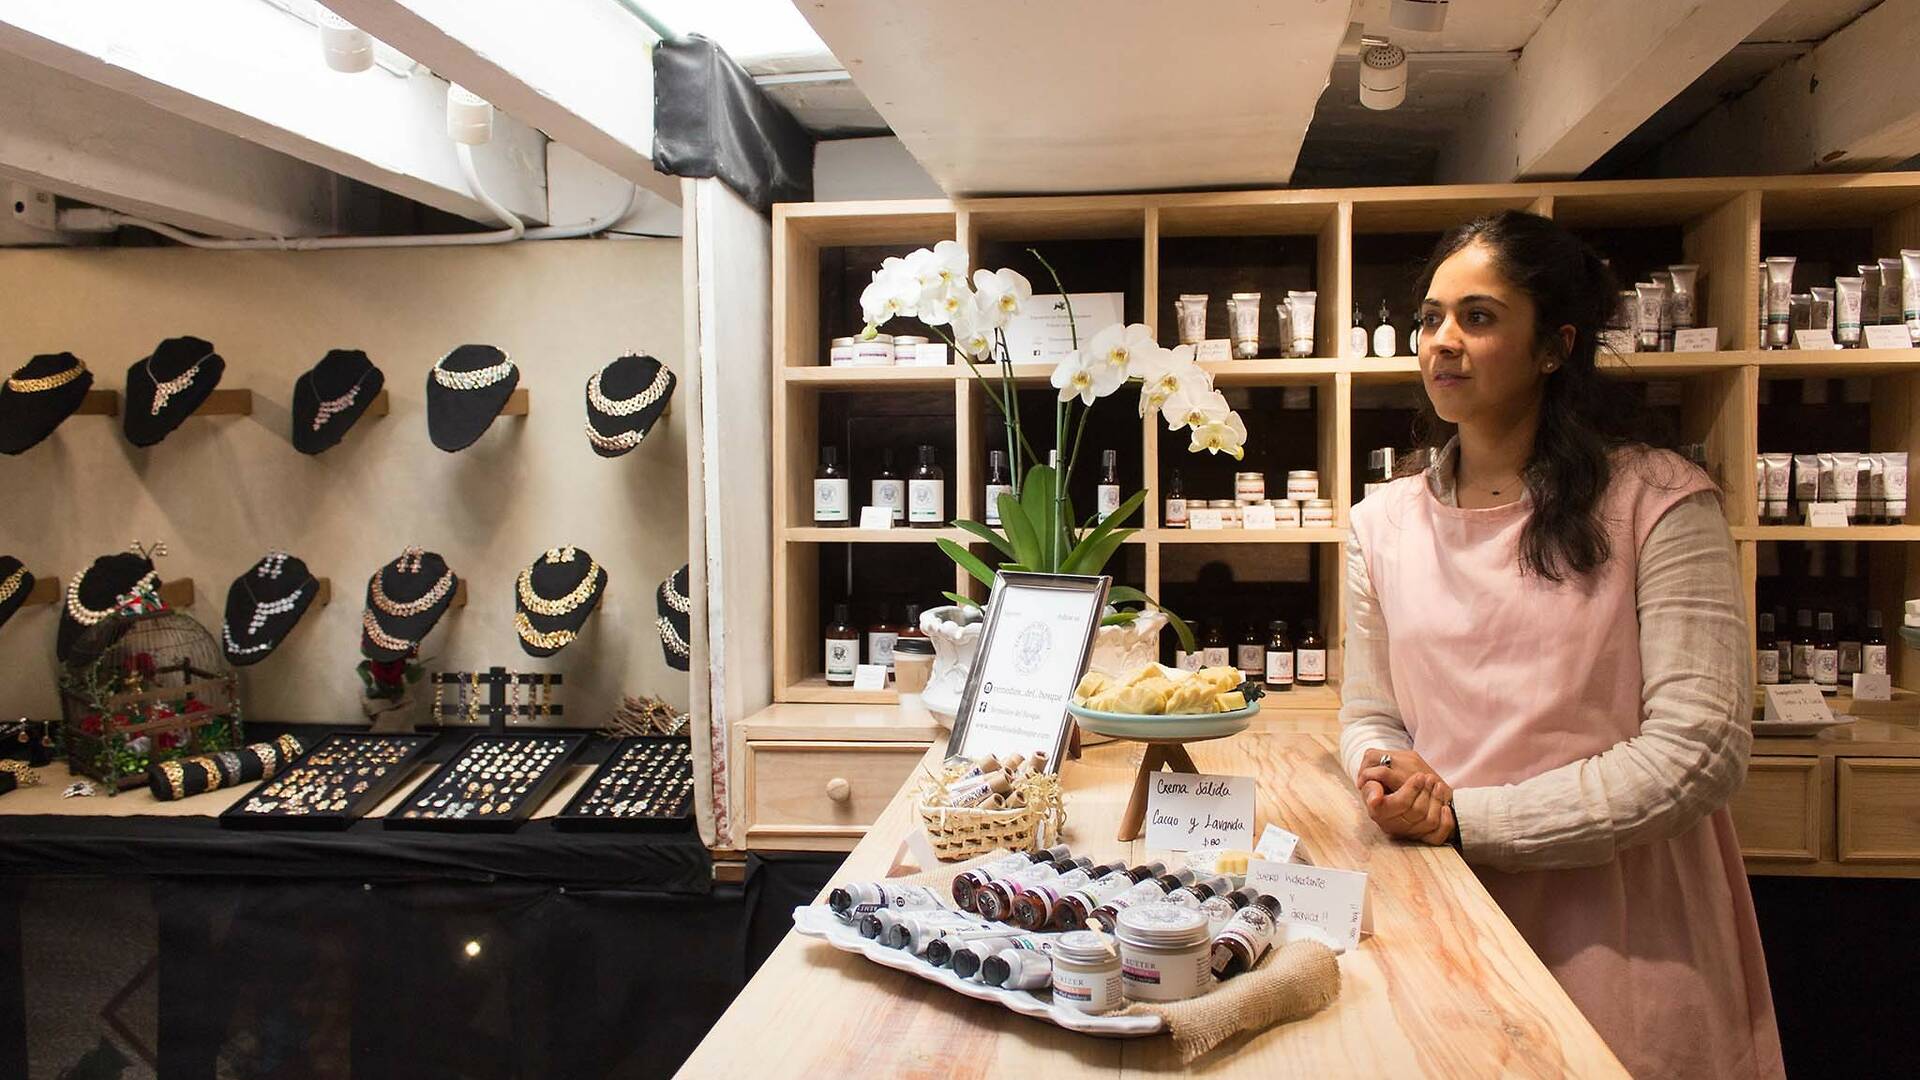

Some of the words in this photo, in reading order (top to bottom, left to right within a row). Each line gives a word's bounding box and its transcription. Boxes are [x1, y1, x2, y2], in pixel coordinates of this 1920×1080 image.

[1157, 778, 1189, 794] Crema
[1152, 809, 1179, 826] Cacao
[1188, 817, 1199, 834] y
[1204, 813, 1245, 831] Lavanda
